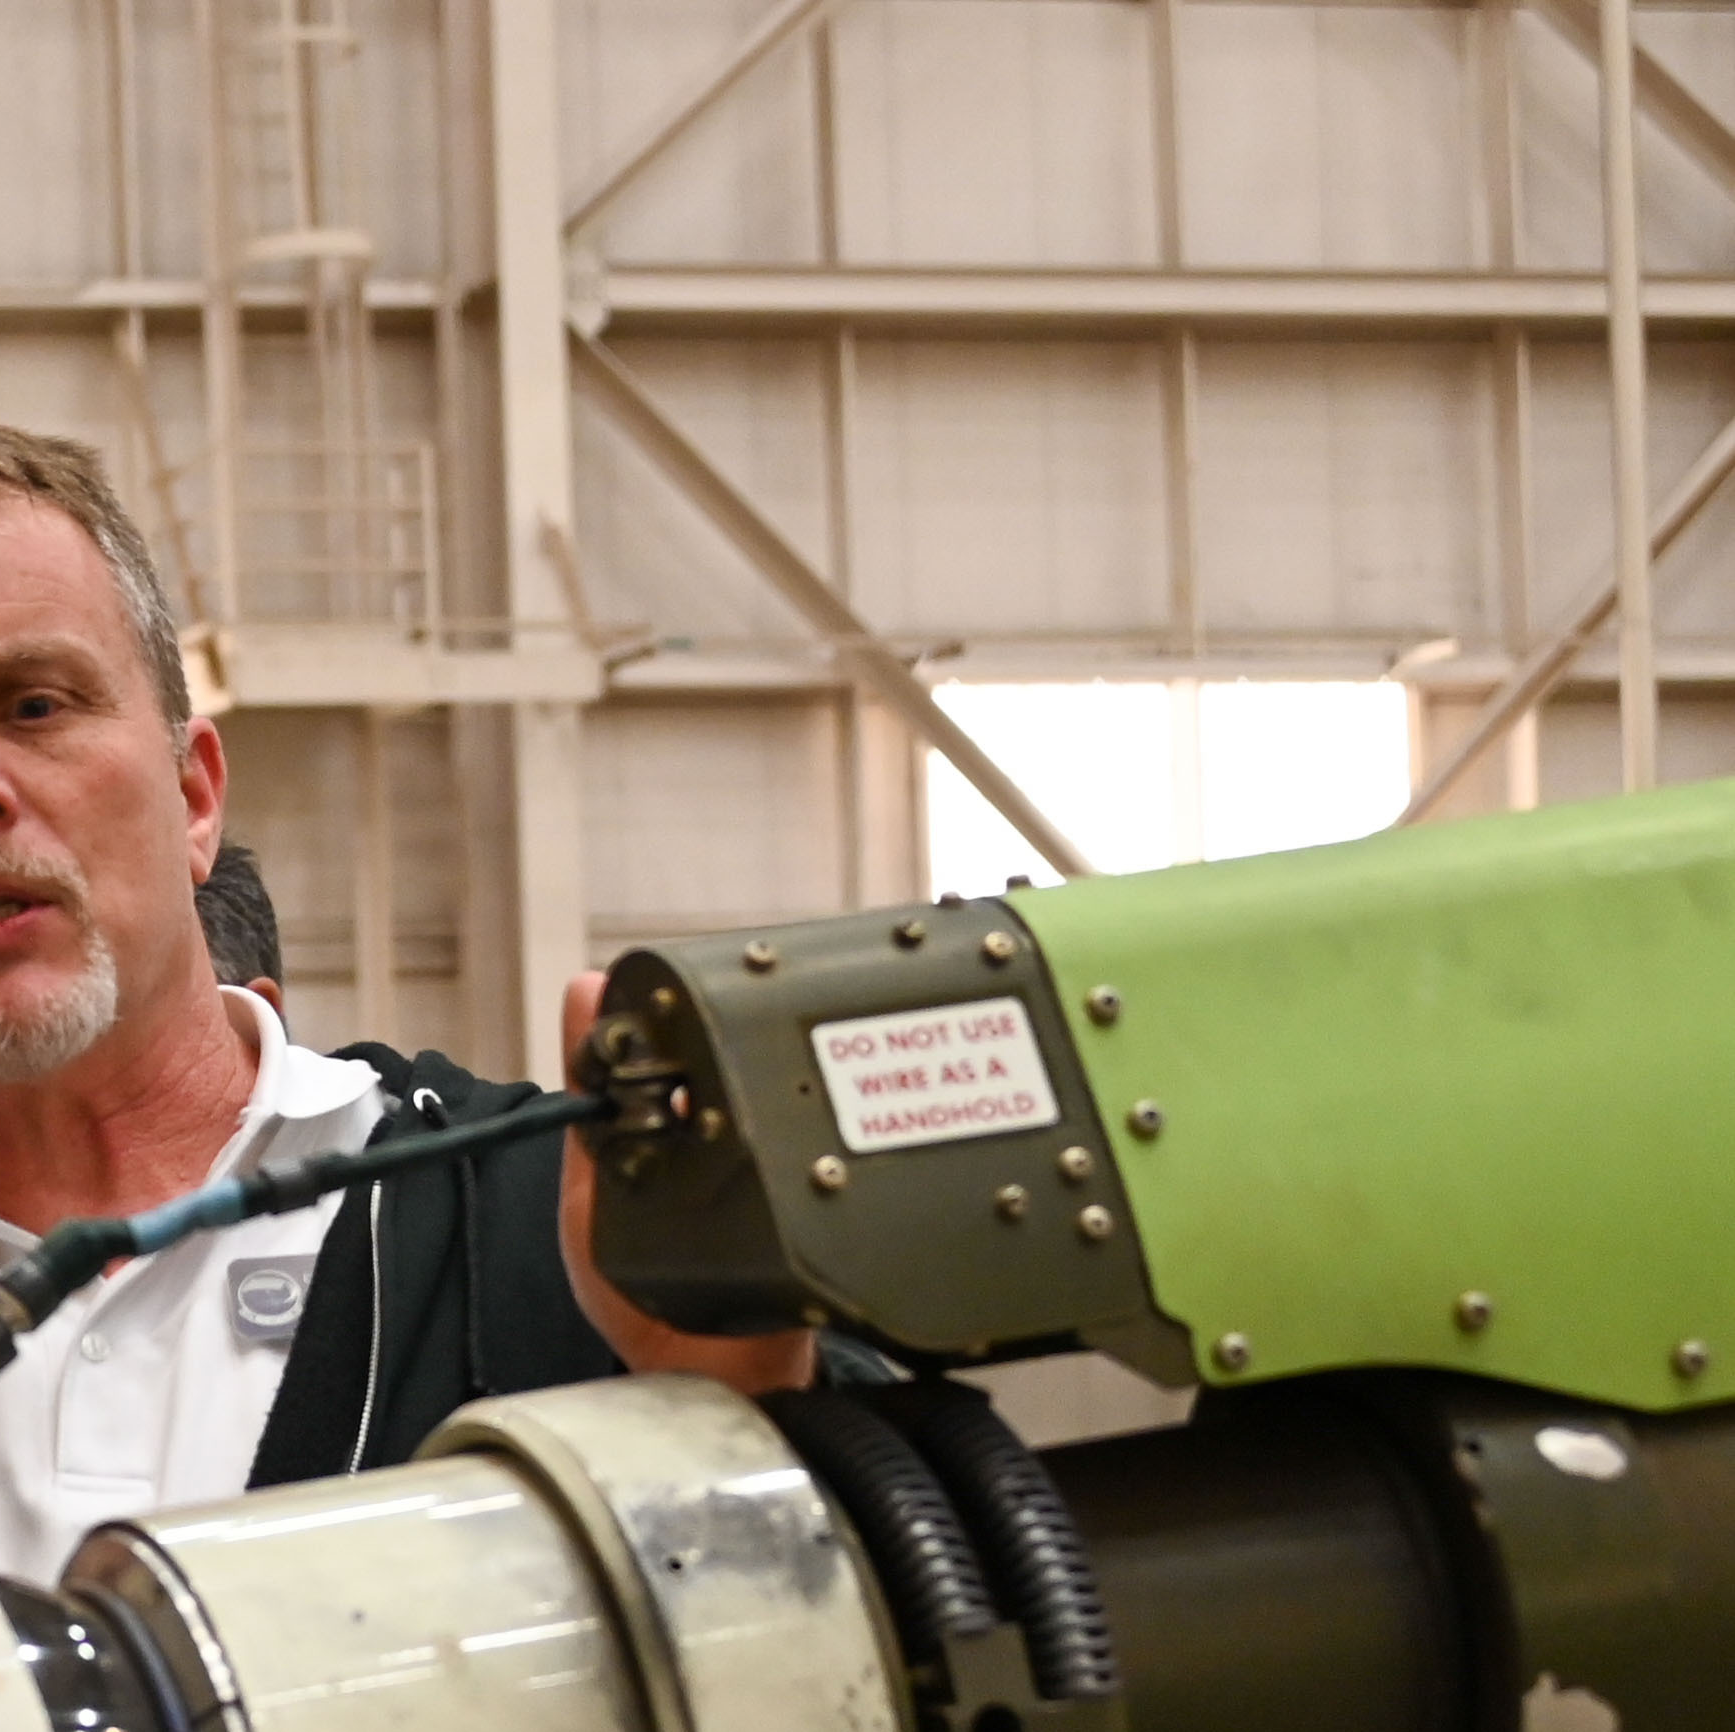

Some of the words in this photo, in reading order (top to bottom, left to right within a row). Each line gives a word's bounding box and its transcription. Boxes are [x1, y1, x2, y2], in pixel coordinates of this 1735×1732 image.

[829, 1035, 875, 1061] DO
[885, 1022, 949, 1049] NOT
[960, 1014, 1016, 1041] USE
[853, 1066, 928, 1095] WIRE
[940, 1058, 976, 1084] AS
[986, 1056, 1007, 1078] A
[860, 1092, 1036, 1136] HANDHOLD
